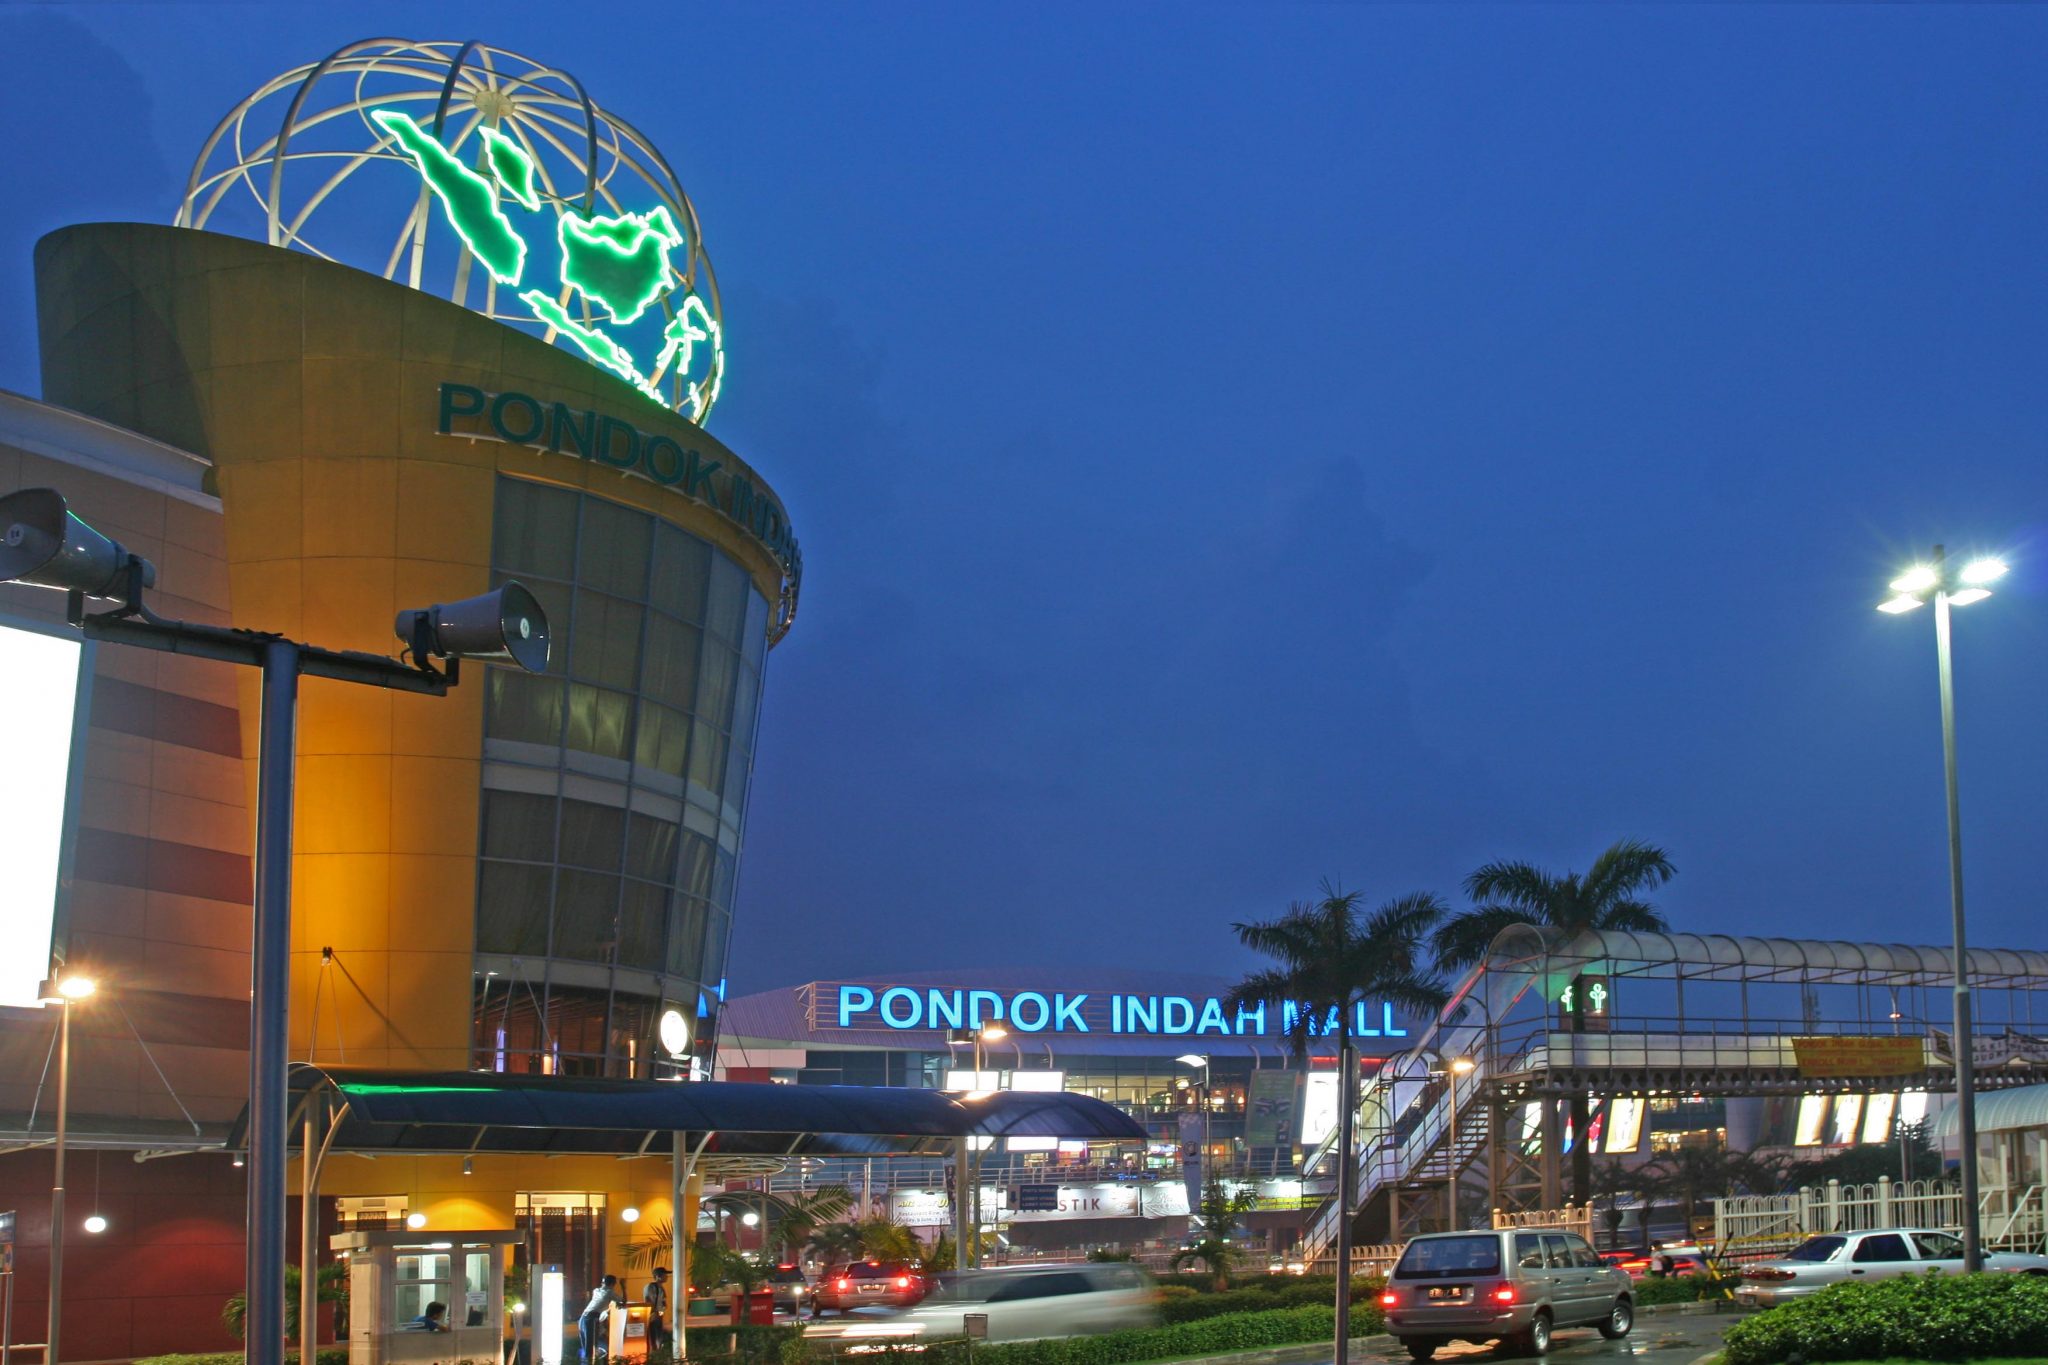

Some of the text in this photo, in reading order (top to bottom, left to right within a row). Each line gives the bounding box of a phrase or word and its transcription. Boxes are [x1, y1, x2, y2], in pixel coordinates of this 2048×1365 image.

[438, 382, 722, 511] PONDOK
[838, 985, 1090, 1033] PONDOK
[1111, 994, 1266, 1036] INDAH
